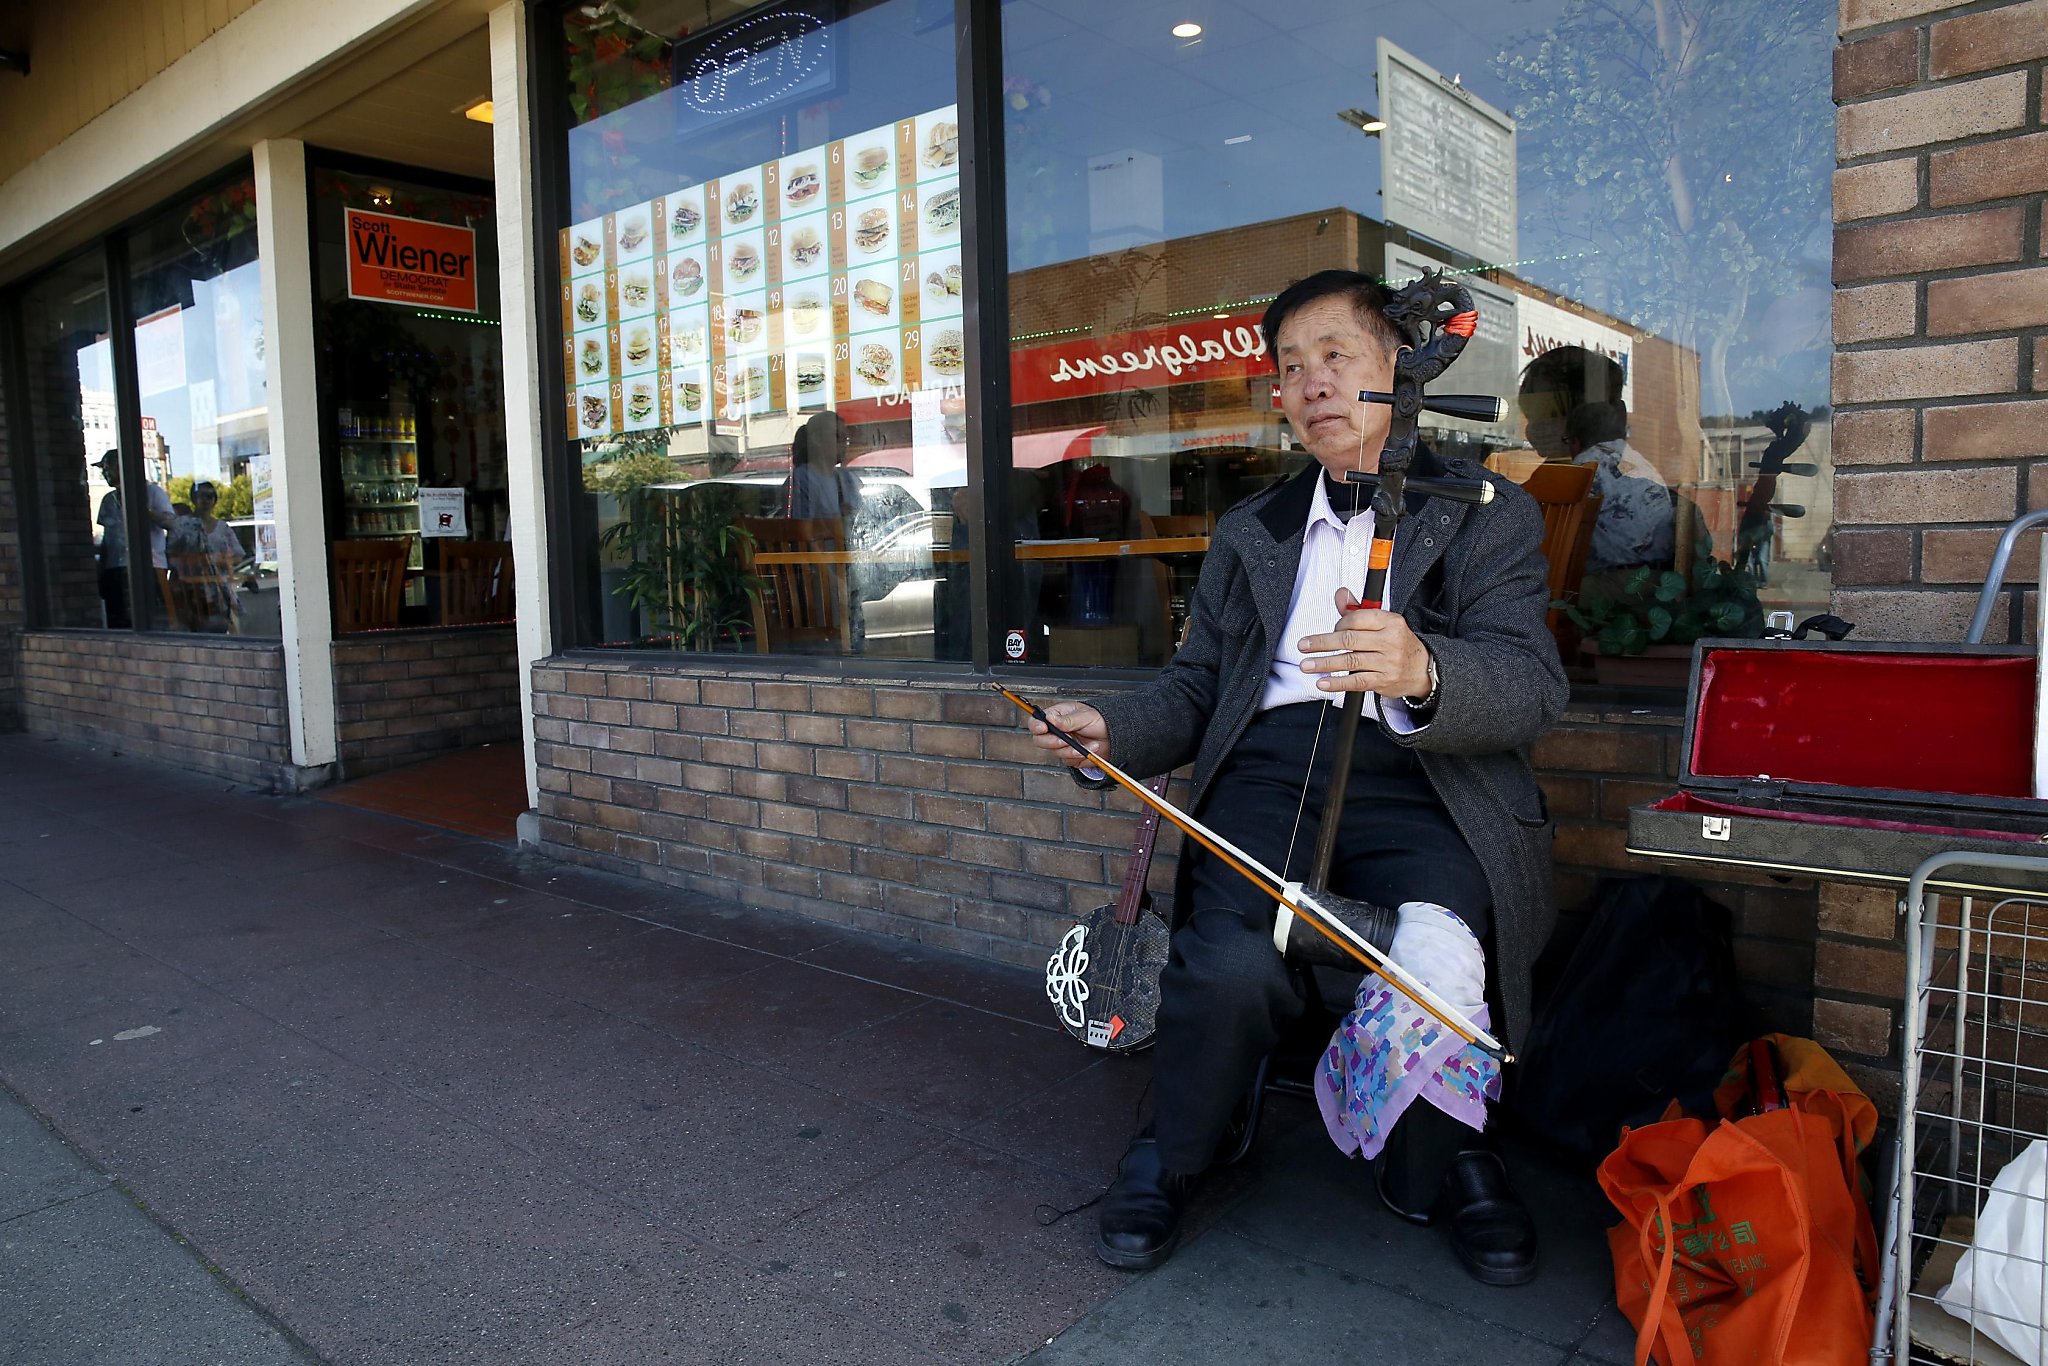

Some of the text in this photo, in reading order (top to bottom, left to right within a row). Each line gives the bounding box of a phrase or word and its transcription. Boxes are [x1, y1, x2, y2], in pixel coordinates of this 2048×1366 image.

[694, 22, 806, 104] OPEN
[902, 124, 911, 144] 7
[831, 146, 840, 164] 6
[768, 166, 775, 184] 5
[709, 185, 717, 201] 4
[656, 202, 663, 218] 3
[901, 192, 915, 213] 14
[352, 216, 390, 234] Scott
[607, 218, 613, 233] 2
[831, 211, 843, 230] 13
[561, 234, 567, 248] 1
[767, 228, 778, 247] 12
[354, 230, 470, 277] Wiener
[709, 245, 718, 262] 11
[656, 259, 666, 276] 10
[902, 261, 915, 282] 21
[380, 271, 449, 288] DEMOCRAT
[609, 274, 615, 289] 9
[833, 277, 847, 297] 20
[564, 286, 570, 301] 8
[769, 291, 780, 309] 19
[711, 304, 722, 322] 18
[658, 317, 668, 333] 17
[609, 329, 618, 344] 16
[904, 330, 919, 350] 29
[565, 339, 573, 354] 15
[835, 342, 849, 361] 28
[771, 354, 784, 372] 27
[713, 364, 726, 381] 25
[611, 383, 622, 399] 23
[660, 374, 672, 392] 24
[566, 392, 576, 408] 22
[1008, 639, 1022, 647] BAY
